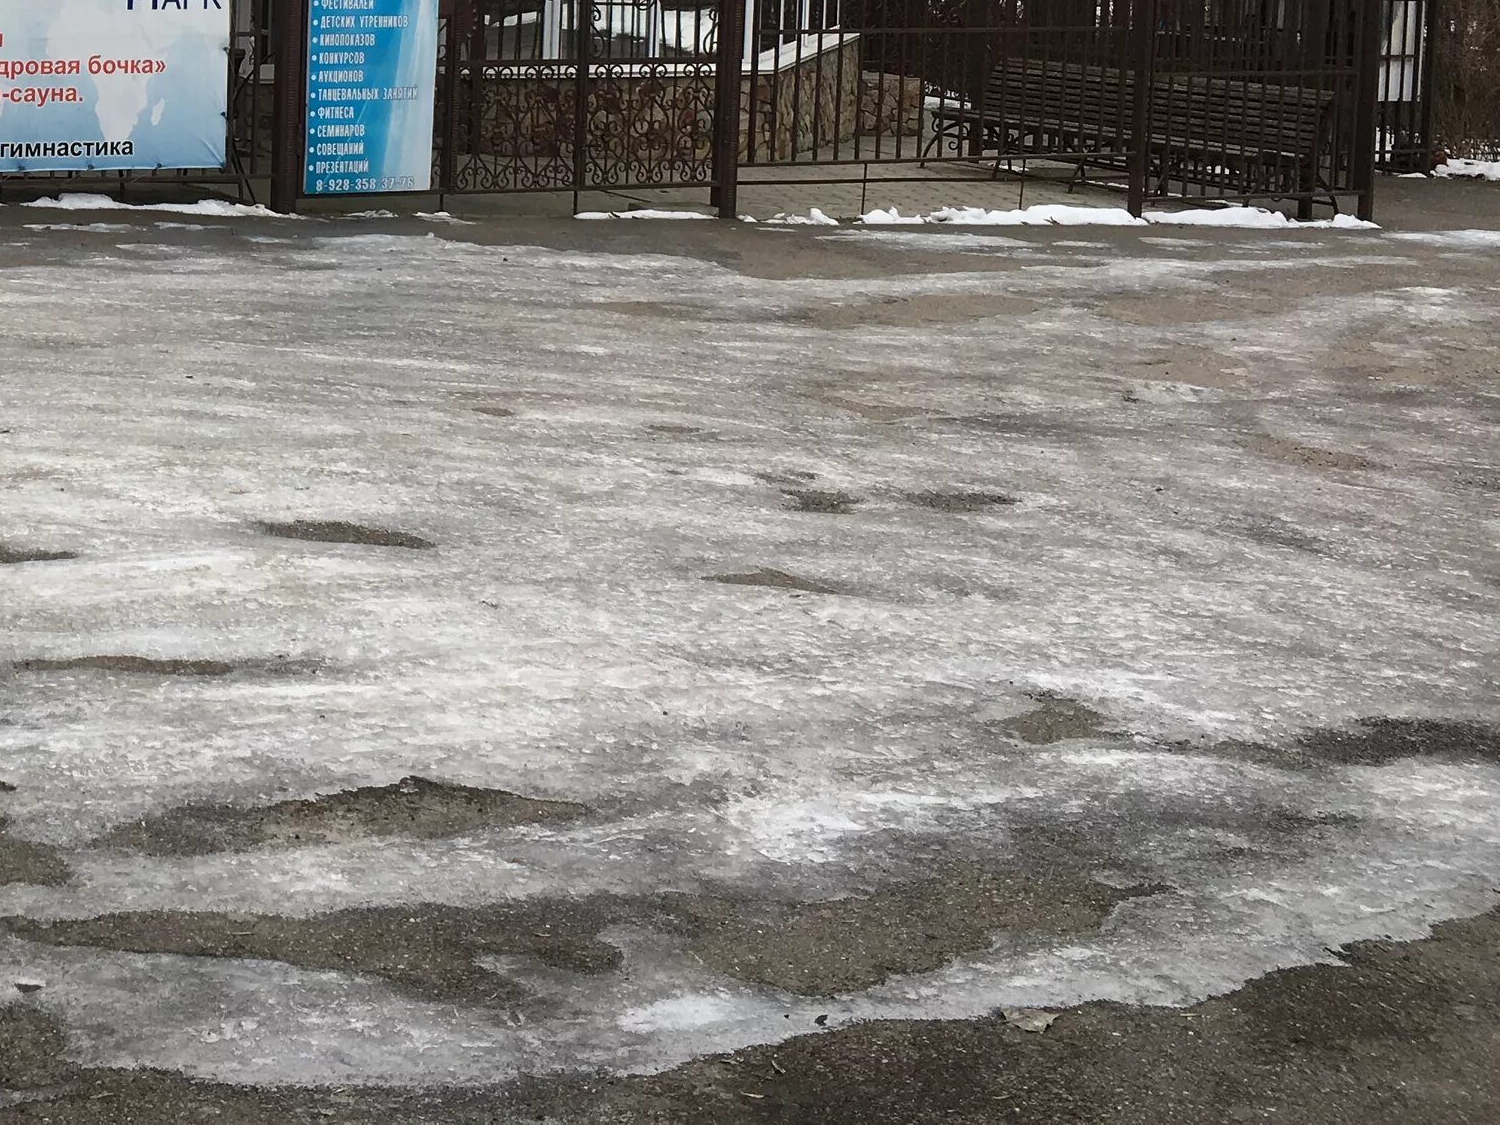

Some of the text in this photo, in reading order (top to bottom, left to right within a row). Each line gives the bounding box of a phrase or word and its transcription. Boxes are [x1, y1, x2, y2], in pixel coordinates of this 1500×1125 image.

[320, 15, 408, 29] ДЕТСКИХ УТРЕННИКОВ
[320, 33, 376, 47] КИНОПОКАЗОВ
[88, 55, 166, 75] бочка»
[319, 51, 365, 65] КОНКУРСОВ
[318, 70, 364, 83] АУКЦИОНОВ
[318, 87, 379, 101] ТАНЦЕВАЛЬНЫХ
[317, 106, 354, 119] ФИТНЕСА
[317, 125, 365, 137] СЕМИНАРОВ
[0, 139, 134, 159] гимнастика
[316, 140, 364, 155] СОВЕЩАНИЙ
[316, 157, 369, 174] ПРЕЗЕНТАЦИЙ
